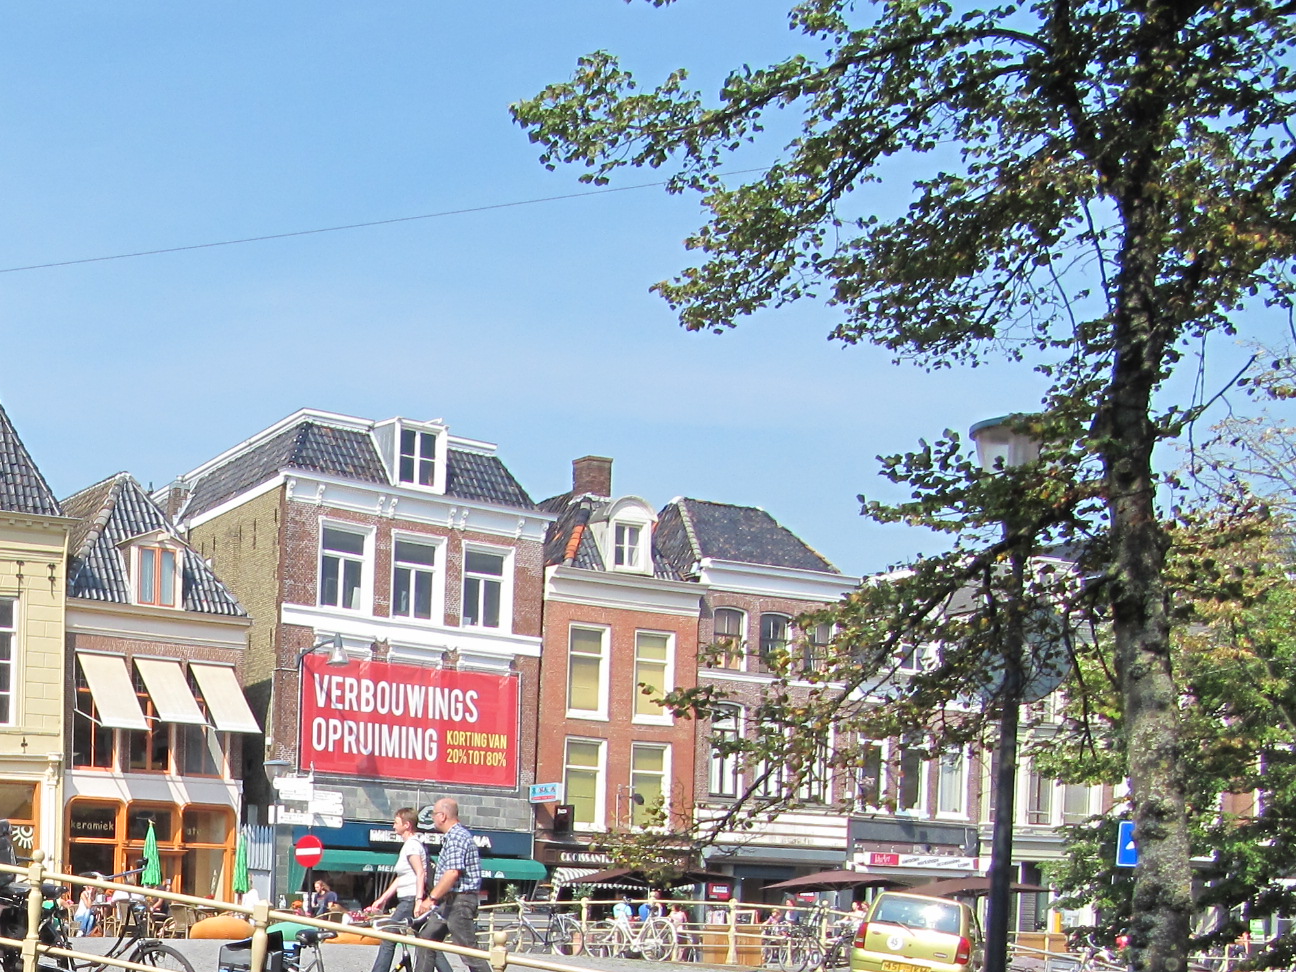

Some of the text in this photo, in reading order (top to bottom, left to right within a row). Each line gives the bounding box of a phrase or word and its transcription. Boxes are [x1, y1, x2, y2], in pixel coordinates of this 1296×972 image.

[314, 673, 479, 723] VERBOUWINGS
[312, 717, 438, 762] OPRUIMING
[446, 730, 507, 750] KORTING VAN
[446, 748, 507, 767] 20% TOT 80%
[70, 820, 115, 831] keramiek
